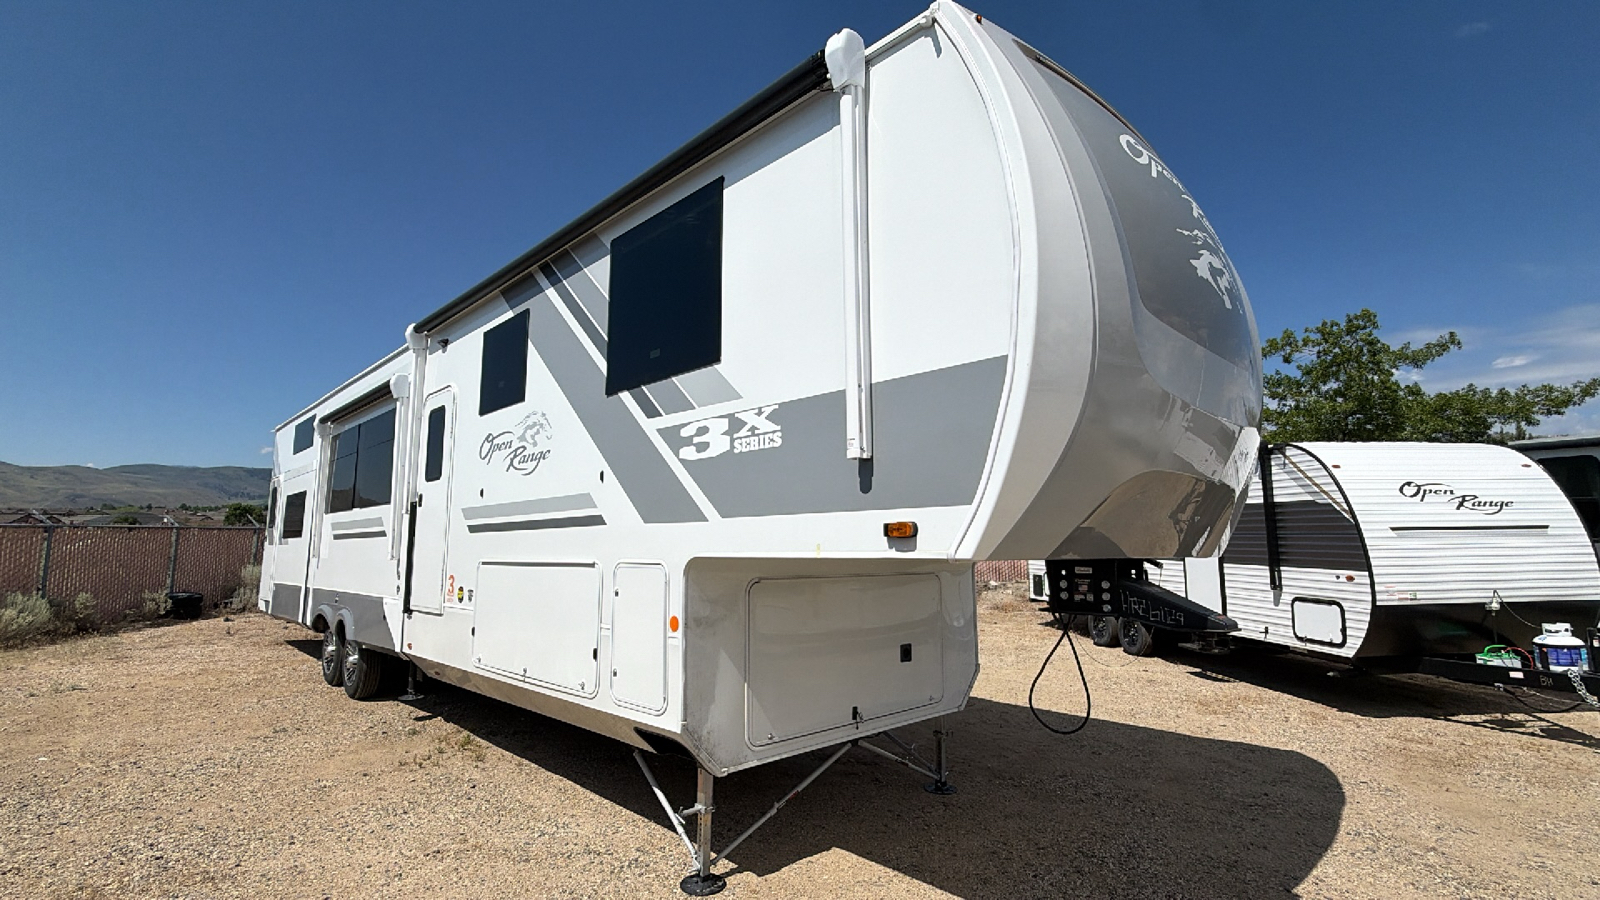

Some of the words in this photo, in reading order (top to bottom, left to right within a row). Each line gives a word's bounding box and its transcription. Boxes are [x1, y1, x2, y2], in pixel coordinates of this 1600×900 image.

[479, 431, 515, 465] Open
[733, 431, 782, 453] SERIES
[503, 445, 551, 476] Range
[1399, 481, 1455, 502] Open
[1447, 494, 1514, 515] Range
